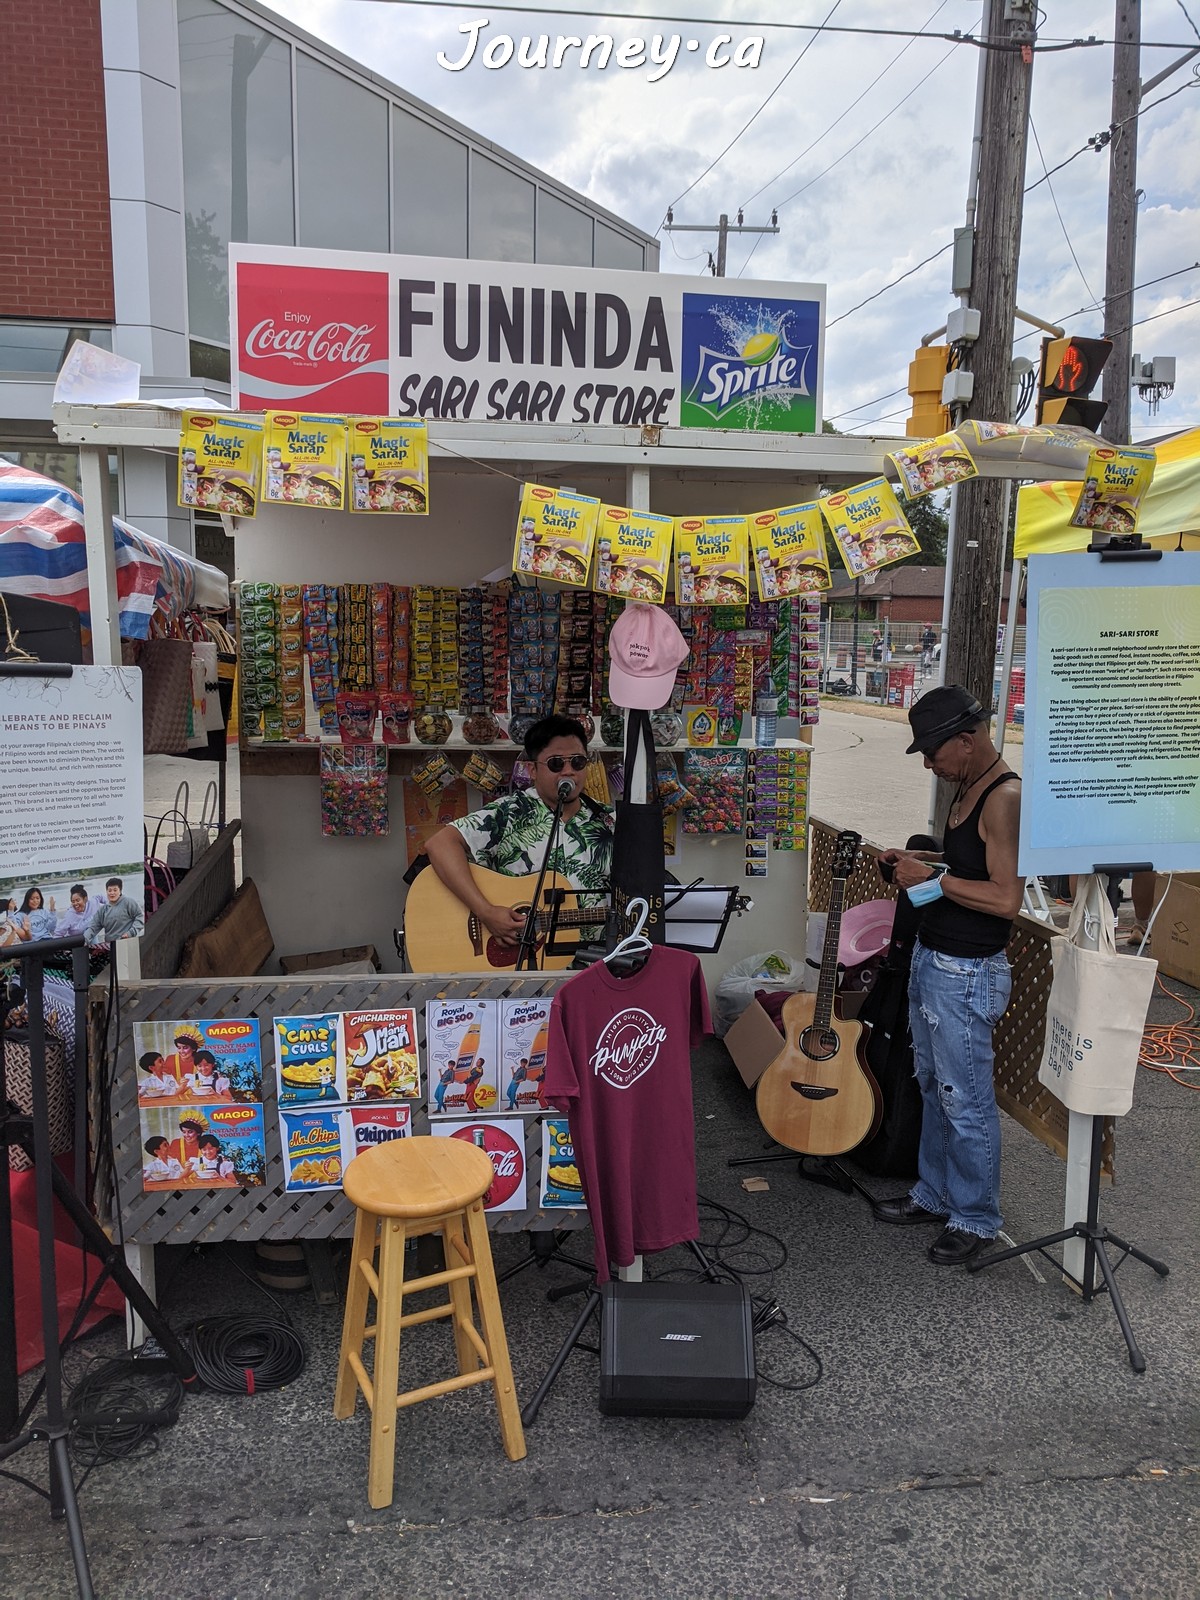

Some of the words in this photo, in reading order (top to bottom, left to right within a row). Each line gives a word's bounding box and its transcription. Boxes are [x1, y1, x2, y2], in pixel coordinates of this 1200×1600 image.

[284, 312, 312, 324] Enjoy
[399, 279, 673, 372] FUNINDA
[246, 318, 376, 363] Coca-Cola
[701, 344, 796, 407] Sprite
[398, 374, 480, 419] SARI
[486, 378, 566, 422] SARI
[572, 382, 675, 425] STORE
[203, 434, 244, 450] Magic
[287, 431, 328, 446] Magic
[370, 436, 410, 451] Magic
[203, 445, 241, 460] Sarap
[288, 443, 324, 455] Sarap
[372, 449, 407, 460] Sarap
[1104, 464, 1138, 480] Magic
[1104, 474, 1133, 486] Sarap
[270, 489, 279, 498] 8g
[913, 484, 922, 492] 8g
[185, 494, 193, 503] 8g
[358, 499, 366, 508] 8g
[542, 504, 581, 520] Magic
[845, 496, 879, 517] Magic
[542, 515, 576, 530] Sarap
[851, 508, 881, 524] Sarap
[618, 524, 655, 540] Magic
[771, 521, 806, 539] Magic
[618, 535, 651, 549] Sarap
[695, 532, 732, 547] Magic
[774, 533, 805, 548] Sarap
[697, 544, 730, 555] Sarap
[521, 560, 528, 570] 8g
[600, 580, 606, 590] 8g
[683, 593, 691, 602] 8g
[650, 895, 662, 908] is
[442, 1005, 465, 1017] Royal
[514, 1004, 538, 1015] Royal
[350, 1014, 407, 1026] CHICHARRON
[437, 1016, 453, 1028] BIG
[454, 1012, 474, 1023] 500
[510, 1015, 526, 1026] BIG
[527, 1010, 546, 1021] 500
[209, 1026, 250, 1035] MAGGI
[376, 1024, 406, 1039] Mang
[607, 1020, 622, 1039] HIGH
[623, 1014, 649, 1027] QUALITY
[1052, 1016, 1072, 1042] there
[1076, 1034, 1093, 1050] is
[287, 1028, 329, 1042] CHIZ
[291, 1042, 328, 1055] CURLS
[352, 1029, 410, 1066] Juan
[1052, 1030, 1084, 1061] tsismis
[1050, 1044, 1056, 1056] in
[1059, 1051, 1073, 1071] this
[625, 1055, 651, 1082] ORIGINAL
[1048, 1057, 1062, 1078] bag
[213, 1111, 255, 1120] MAGGI
[290, 1130, 308, 1146] Mr.
[309, 1127, 339, 1144] Chips
